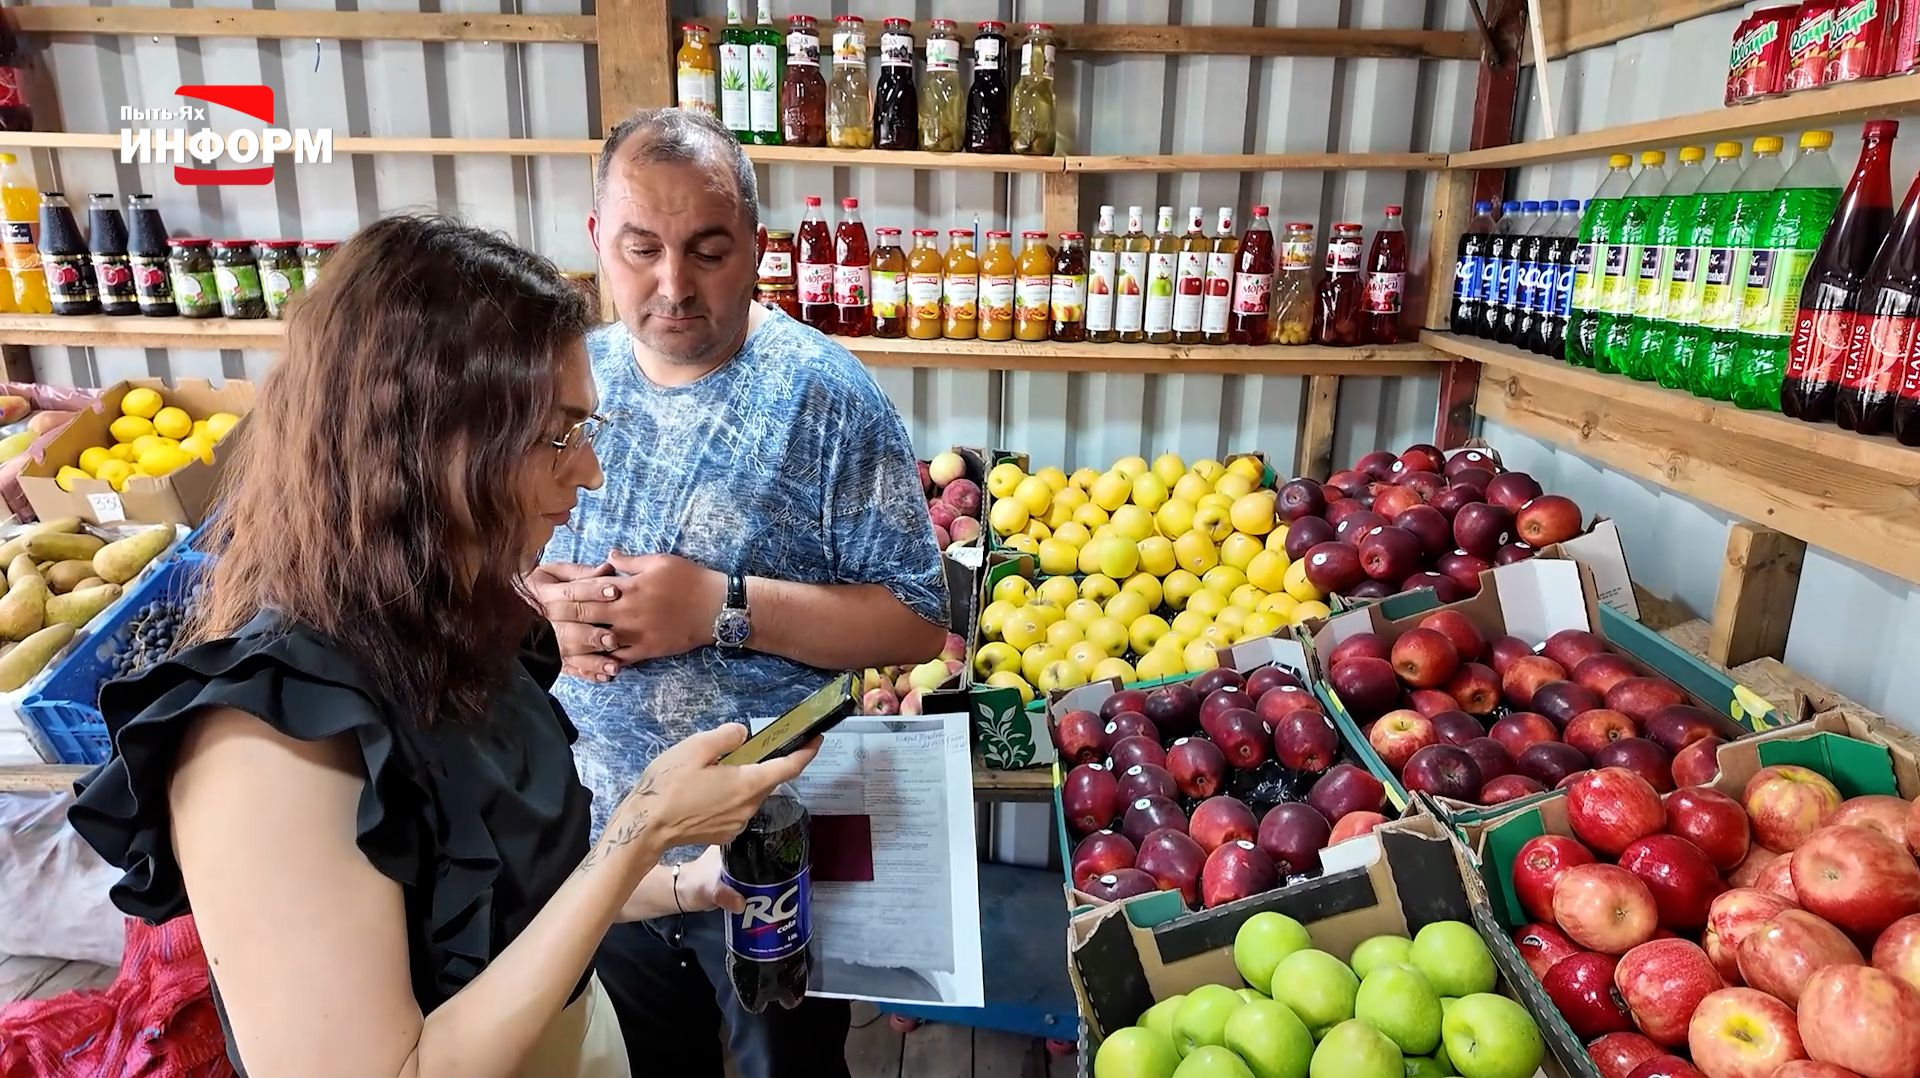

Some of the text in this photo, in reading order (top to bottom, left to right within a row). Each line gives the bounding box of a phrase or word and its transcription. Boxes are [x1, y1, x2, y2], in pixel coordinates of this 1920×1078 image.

[1790, 17, 1832, 51] Roya
[1793, 319, 1812, 371] FLAVIS
[1845, 325, 1866, 380] FLAVIS
[741, 884, 799, 930] RC
[776, 919, 797, 934] cola
